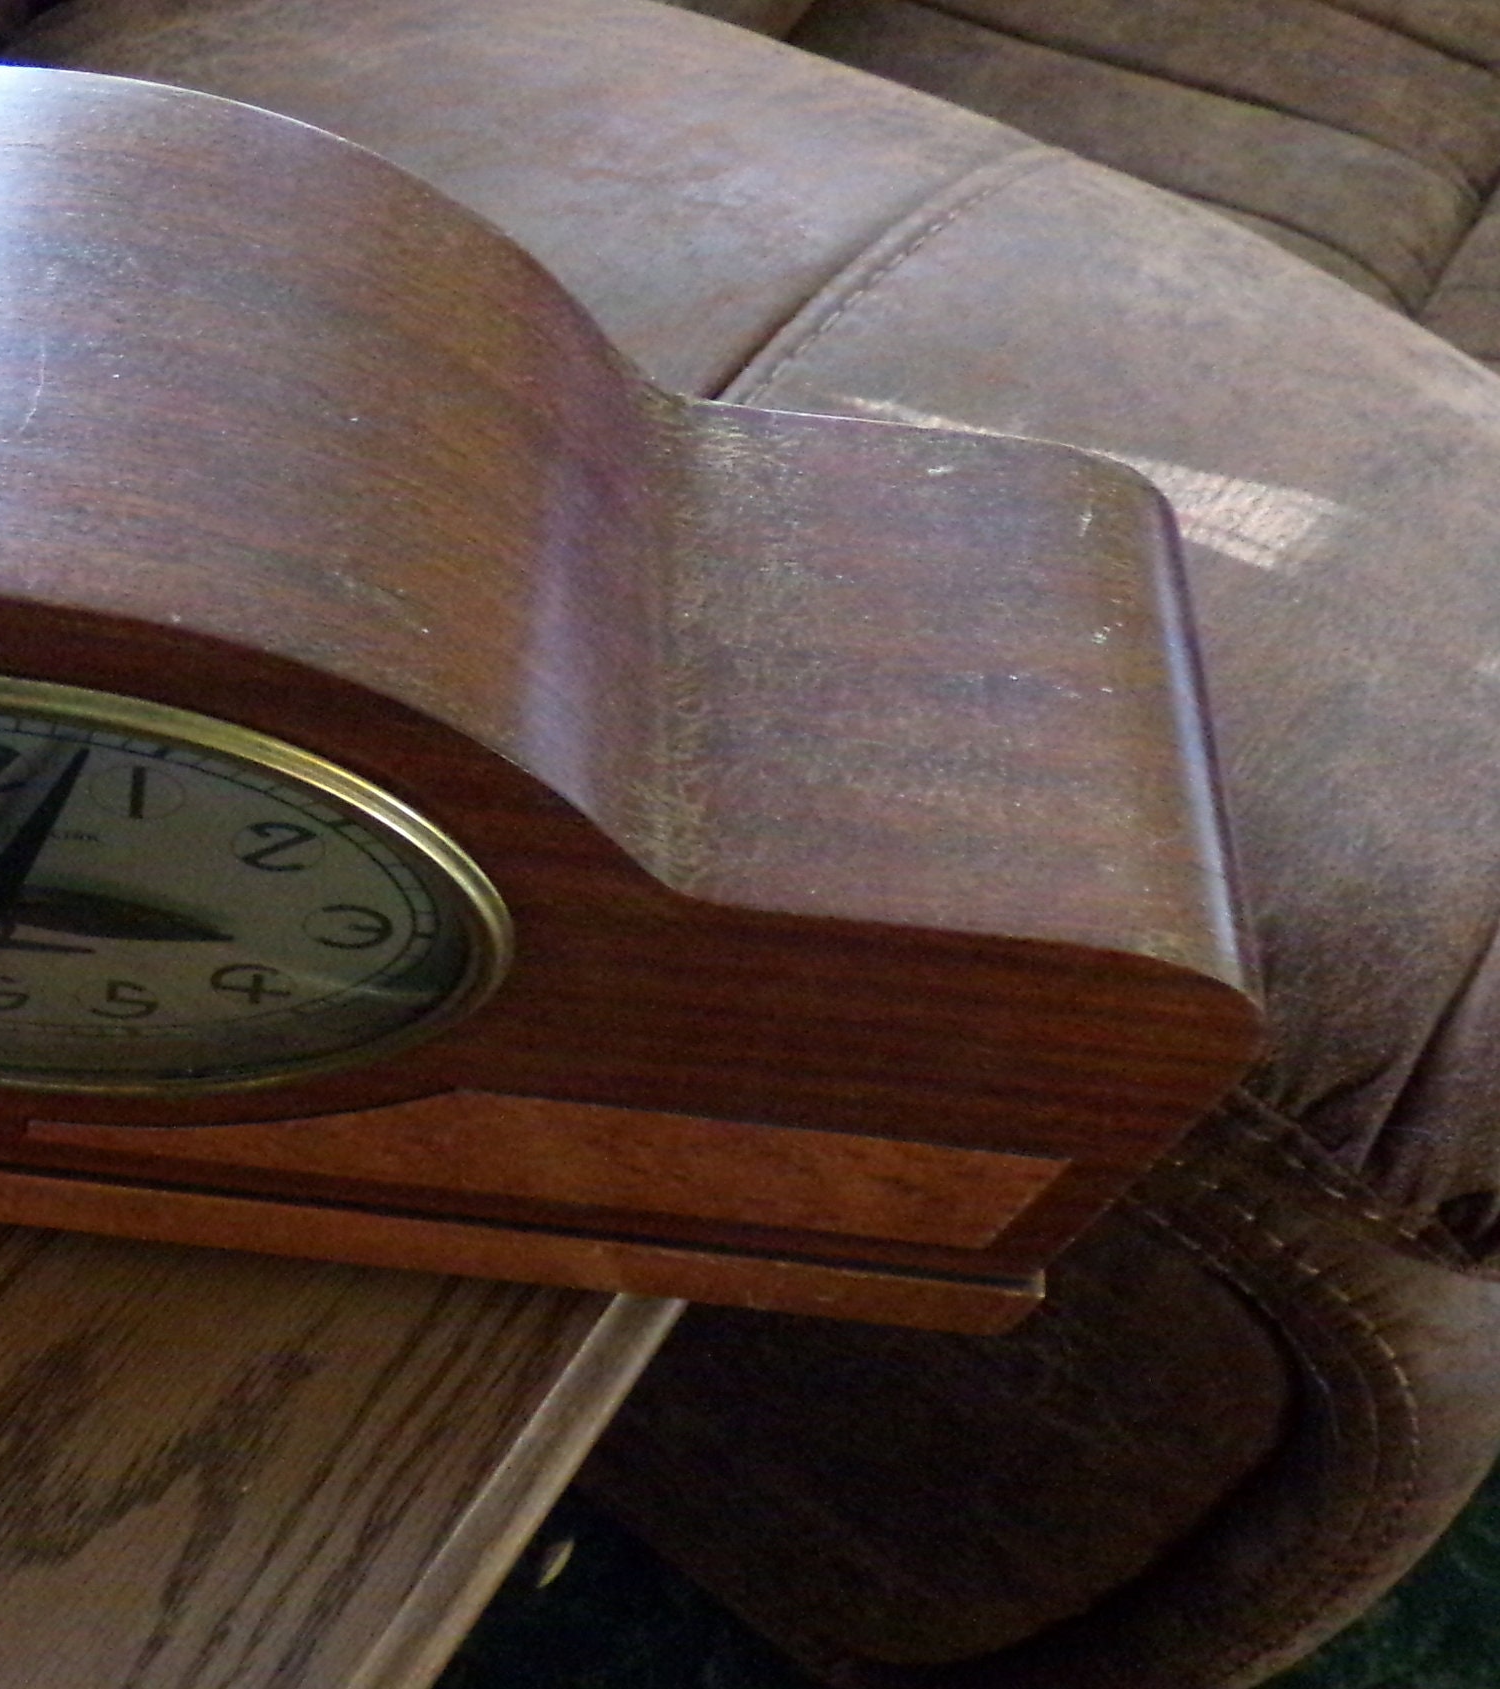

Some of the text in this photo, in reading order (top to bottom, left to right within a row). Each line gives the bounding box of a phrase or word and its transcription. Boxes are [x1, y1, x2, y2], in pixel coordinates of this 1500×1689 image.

[129, 765, 146, 820] 1
[238, 819, 318, 873] 2
[314, 903, 395, 951] 3
[91, 978, 160, 1020] 5
[210, 962, 292, 1006] 4
